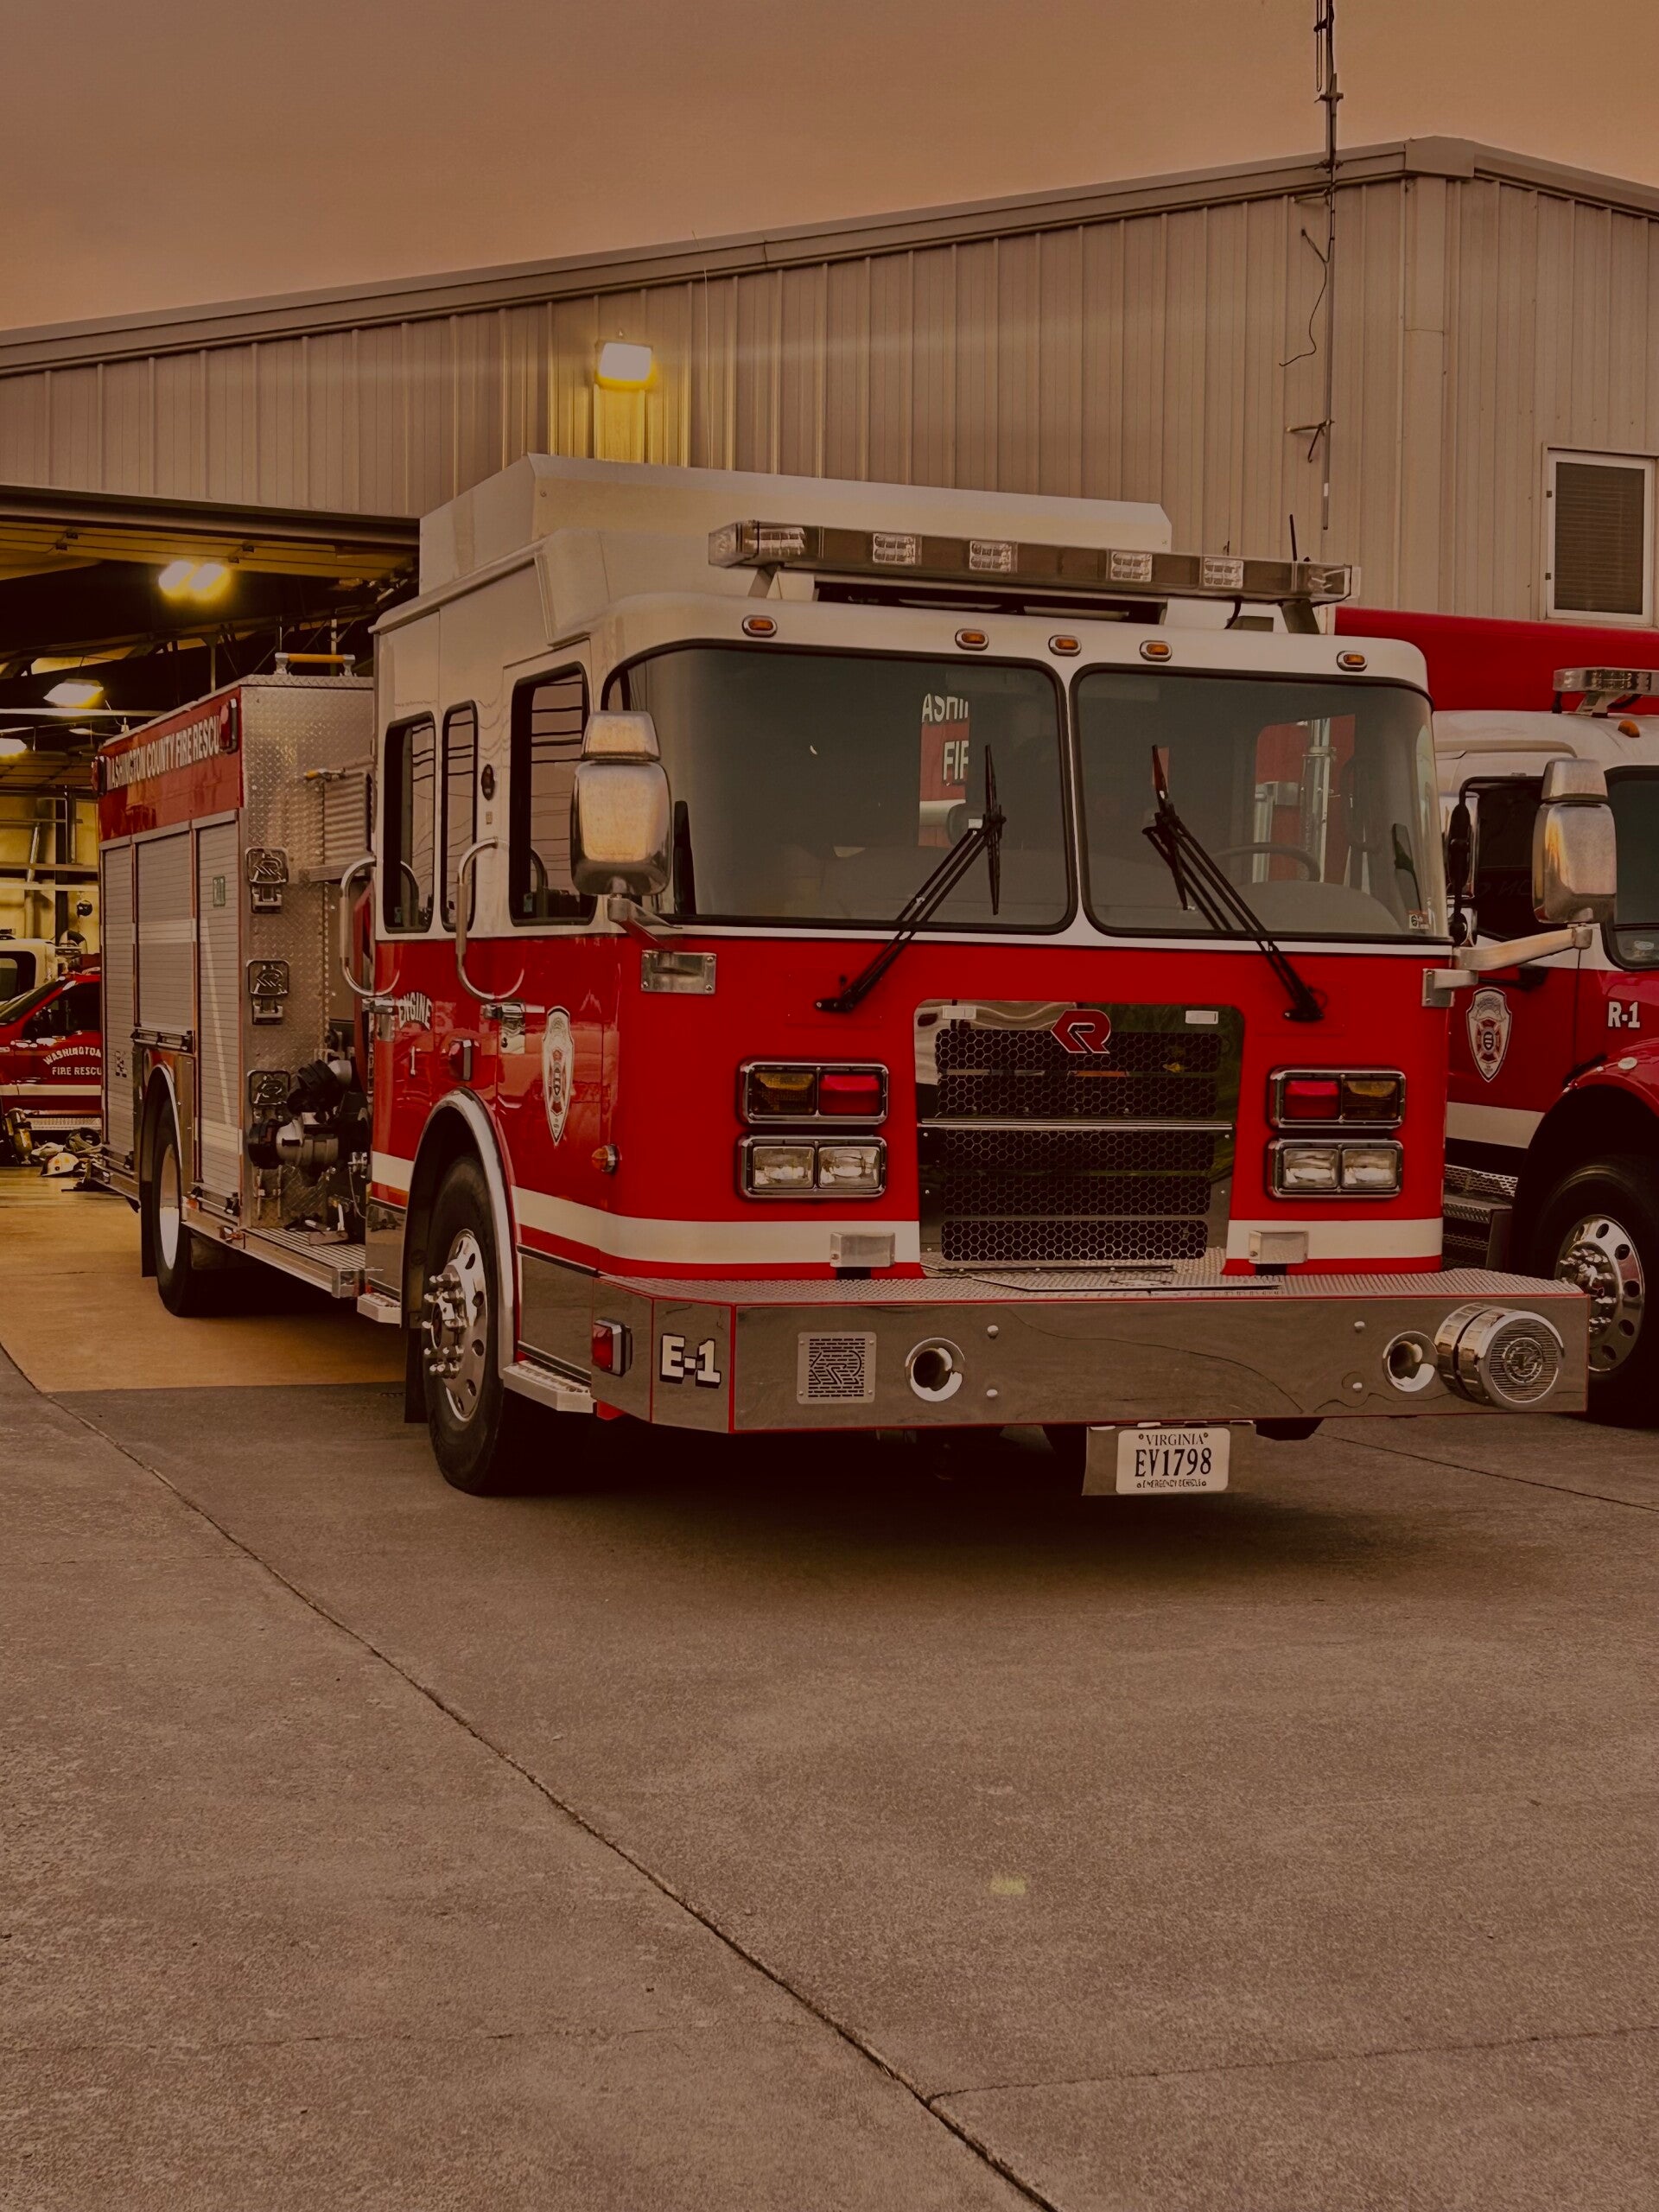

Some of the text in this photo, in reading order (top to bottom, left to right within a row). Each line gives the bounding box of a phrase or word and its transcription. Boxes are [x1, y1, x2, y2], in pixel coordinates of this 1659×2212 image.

[175, 728, 192, 768] FIRE
[193, 715, 219, 761] RESCU
[398, 991, 432, 1030] ENGINE
[1607, 1001, 1640, 1028] R-1
[52, 1066, 102, 1076] FIRE RESCU
[659, 1333, 722, 1389] E-1
[1146, 1433, 1205, 1446] VIRGINIA
[1135, 1447, 1212, 1477] EV1798
